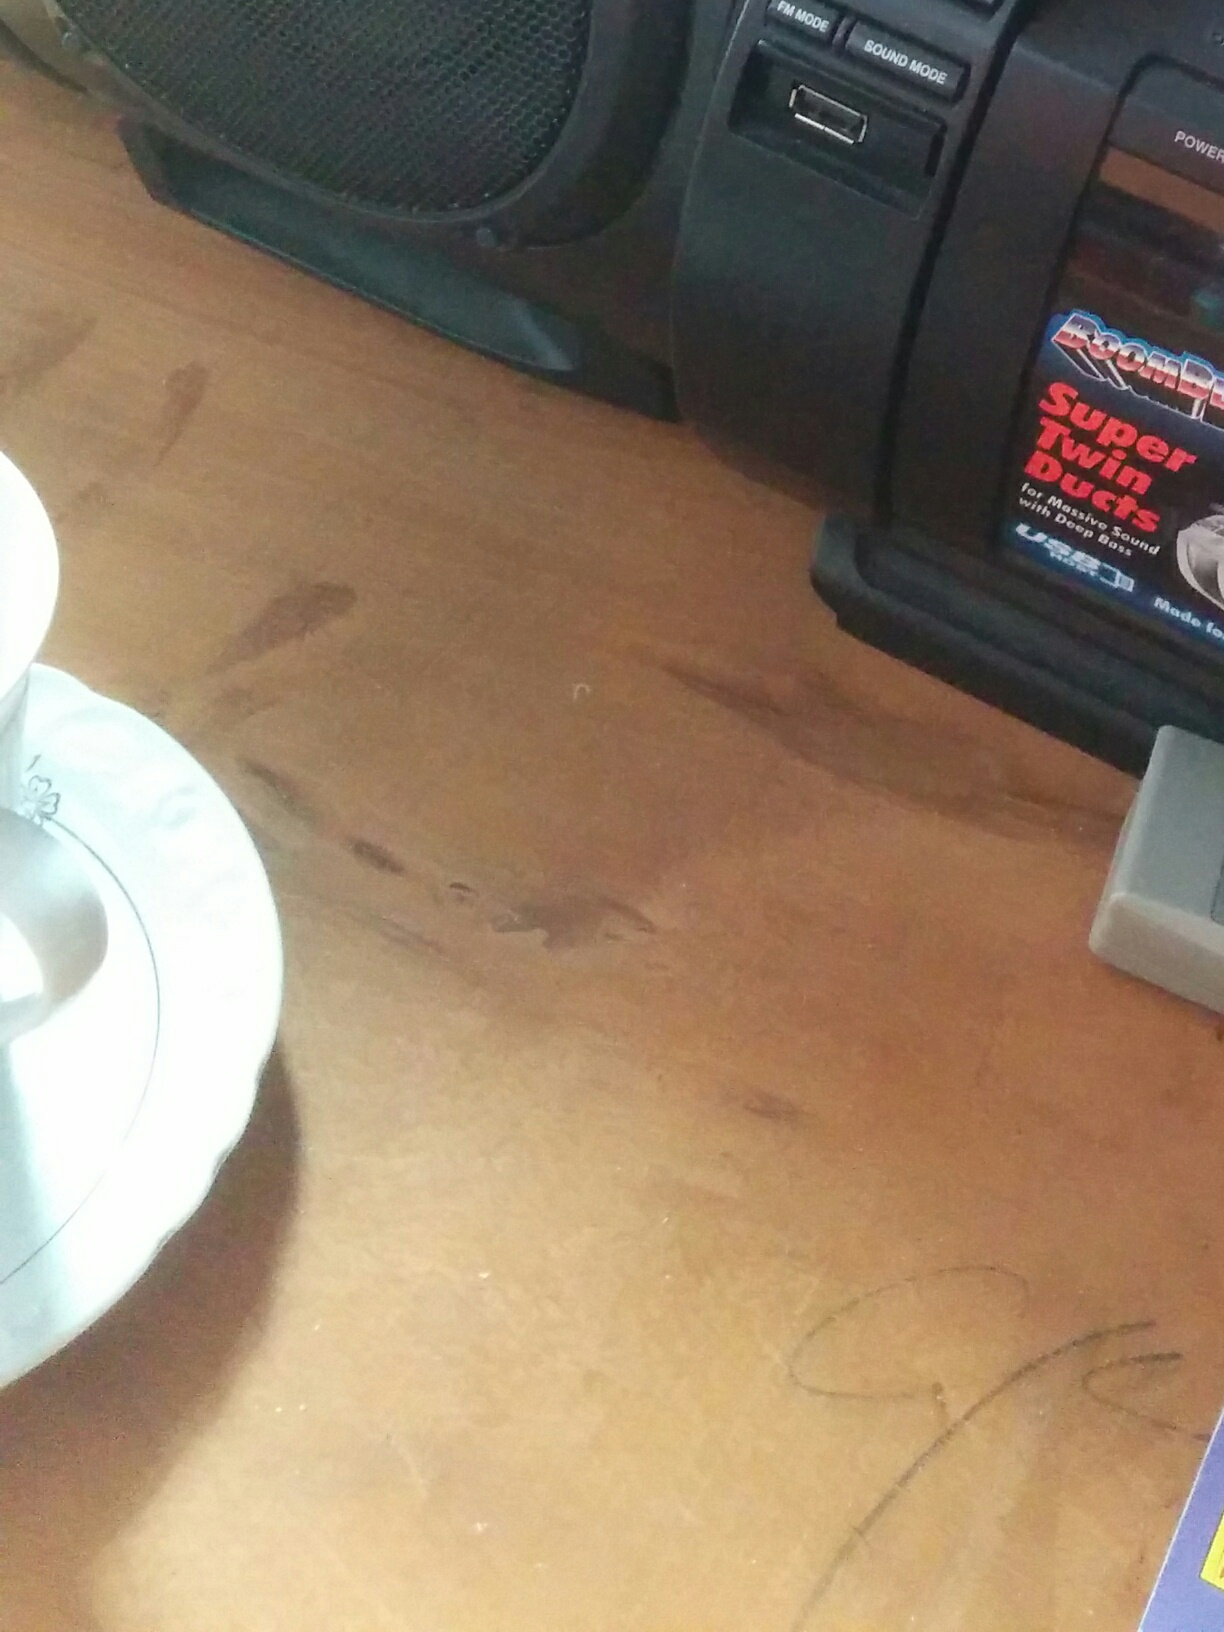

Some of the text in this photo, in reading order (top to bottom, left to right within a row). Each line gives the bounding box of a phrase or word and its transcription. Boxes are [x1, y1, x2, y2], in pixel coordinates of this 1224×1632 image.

[776, 0, 830, 33] FM MODE
[863, 39, 948, 85] SOUND MODE
[1037, 416, 1153, 495] Twin
[1038, 381, 1198, 473] Super
[1020, 482, 1161, 556] for Massive Sound
[1024, 450, 1161, 533] Ducts
[1015, 522, 1102, 570] USB
[1019, 497, 1132, 557] with Deep Bass
[1154, 597, 1201, 627] Made
